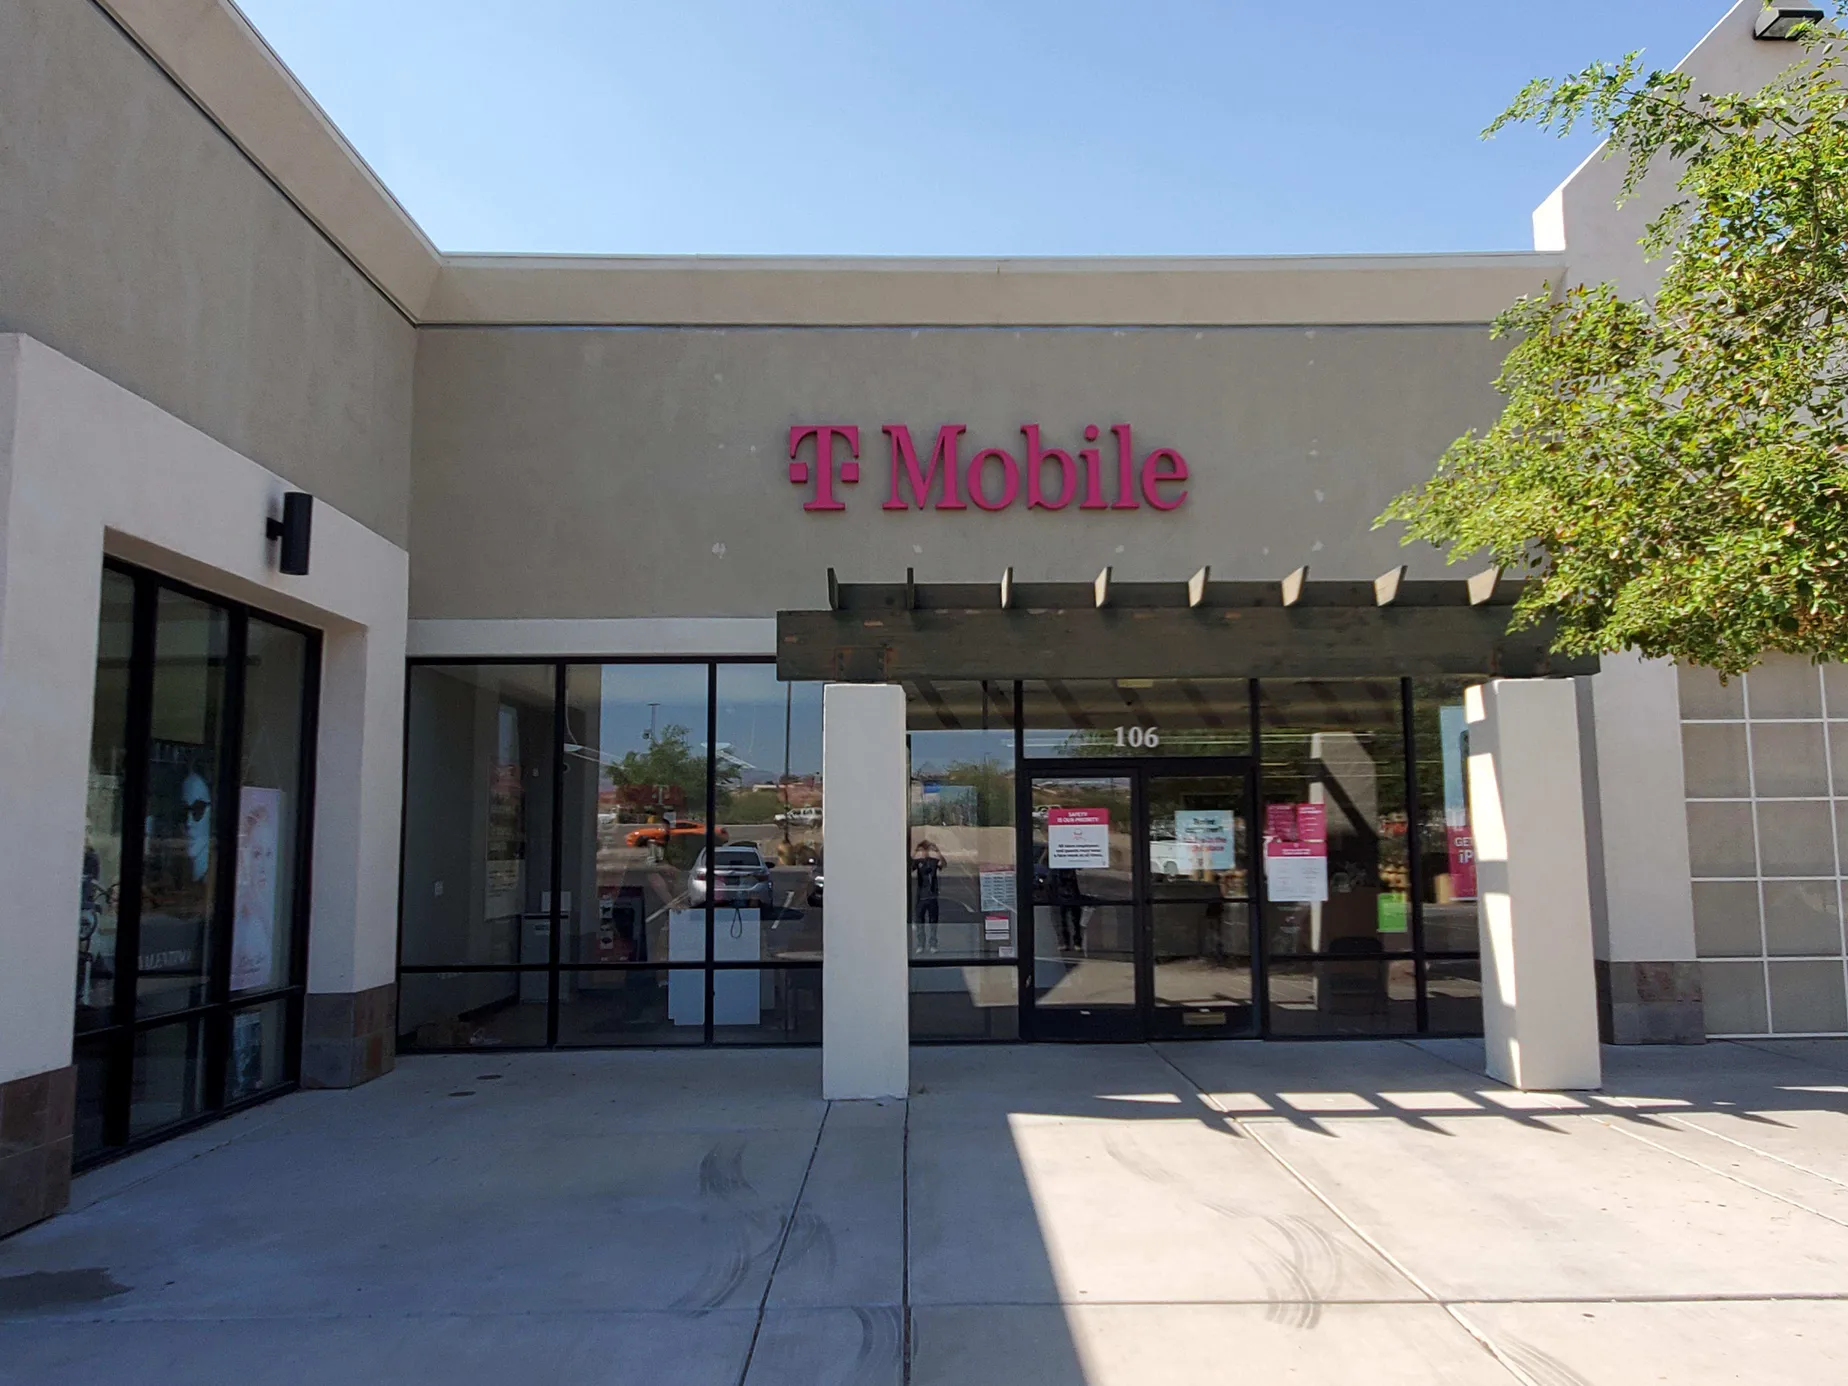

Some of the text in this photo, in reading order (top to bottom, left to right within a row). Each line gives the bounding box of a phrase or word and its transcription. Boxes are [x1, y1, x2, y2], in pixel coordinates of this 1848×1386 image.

[789, 424, 1189, 511] T Mobile
[1113, 726, 1159, 748] 106
